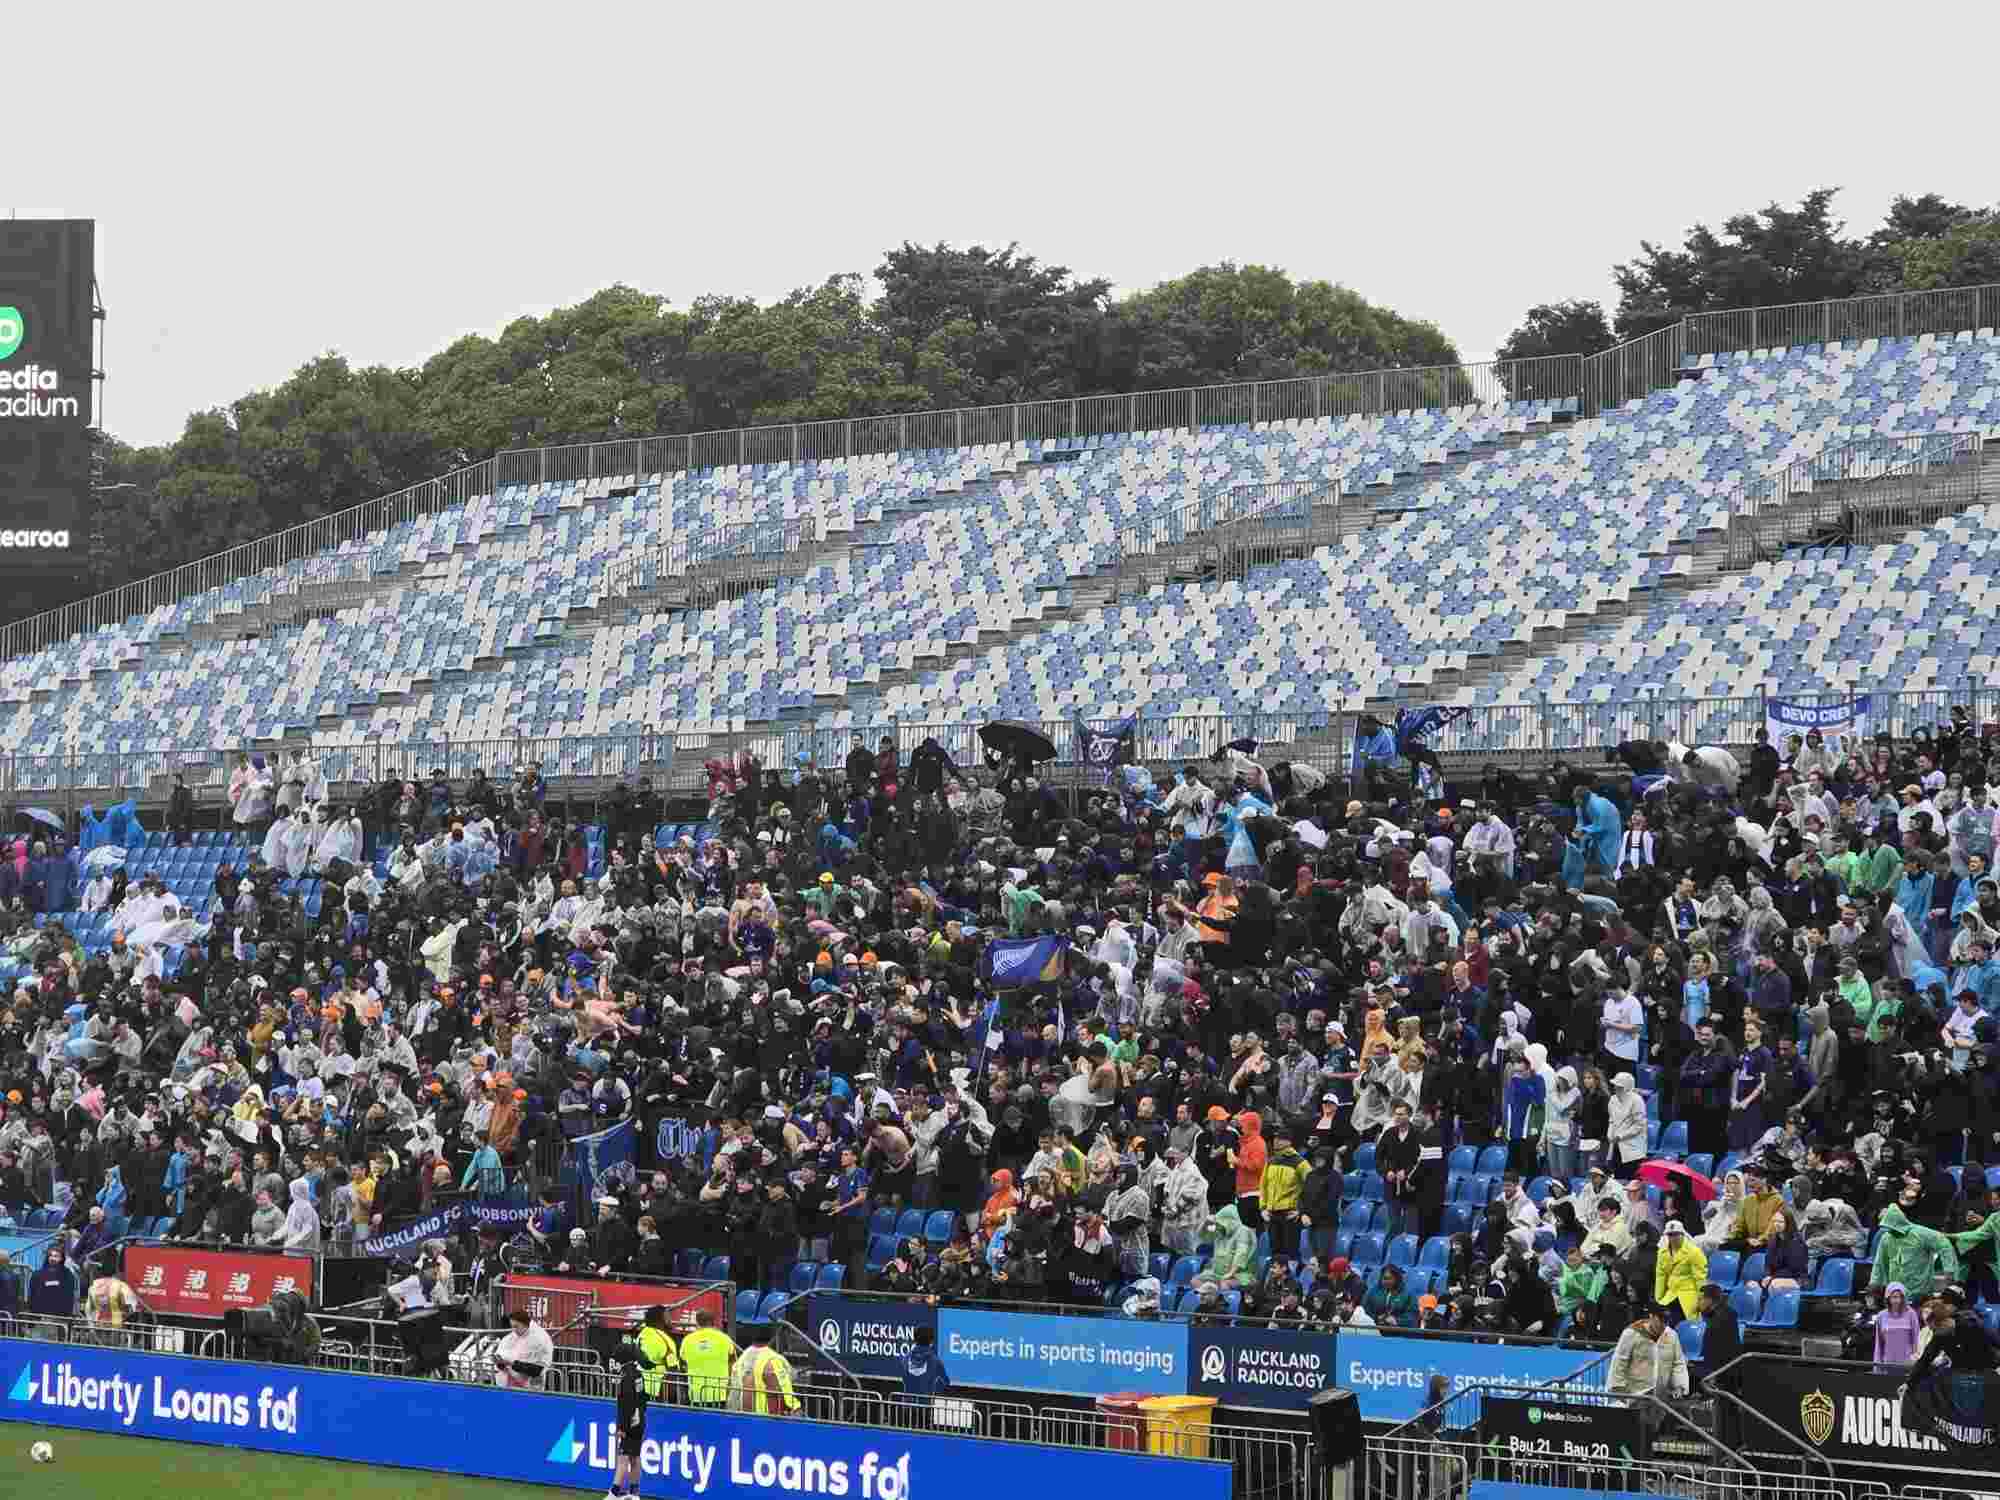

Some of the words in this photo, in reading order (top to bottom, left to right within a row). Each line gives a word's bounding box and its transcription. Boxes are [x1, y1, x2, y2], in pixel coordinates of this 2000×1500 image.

[365, 1216, 440, 1253] AUCKLAND
[443, 1205, 462, 1224] FC
[851, 1322, 915, 1341] AUCKLAN
[950, 1333, 1014, 1361] Experts
[1019, 1337, 1035, 1360] in
[1039, 1340, 1096, 1366] sports
[1100, 1341, 1174, 1374] imaging
[1238, 1349, 1321, 1370] AUCKLAND
[1237, 1367, 1327, 1390] RADIOLOGY
[1350, 1359, 1424, 1391] Experts
[40, 1362, 143, 1426] Liberty
[153, 1375, 251, 1427] Loans
[588, 1422, 717, 1493] Lierty
[730, 1438, 850, 1496] Loans
[1509, 1436, 1534, 1456] Bay
[1536, 1438, 1551, 1454] 21
[1564, 1440, 1589, 1460] Bay
[1591, 1442, 1609, 1458] 20
